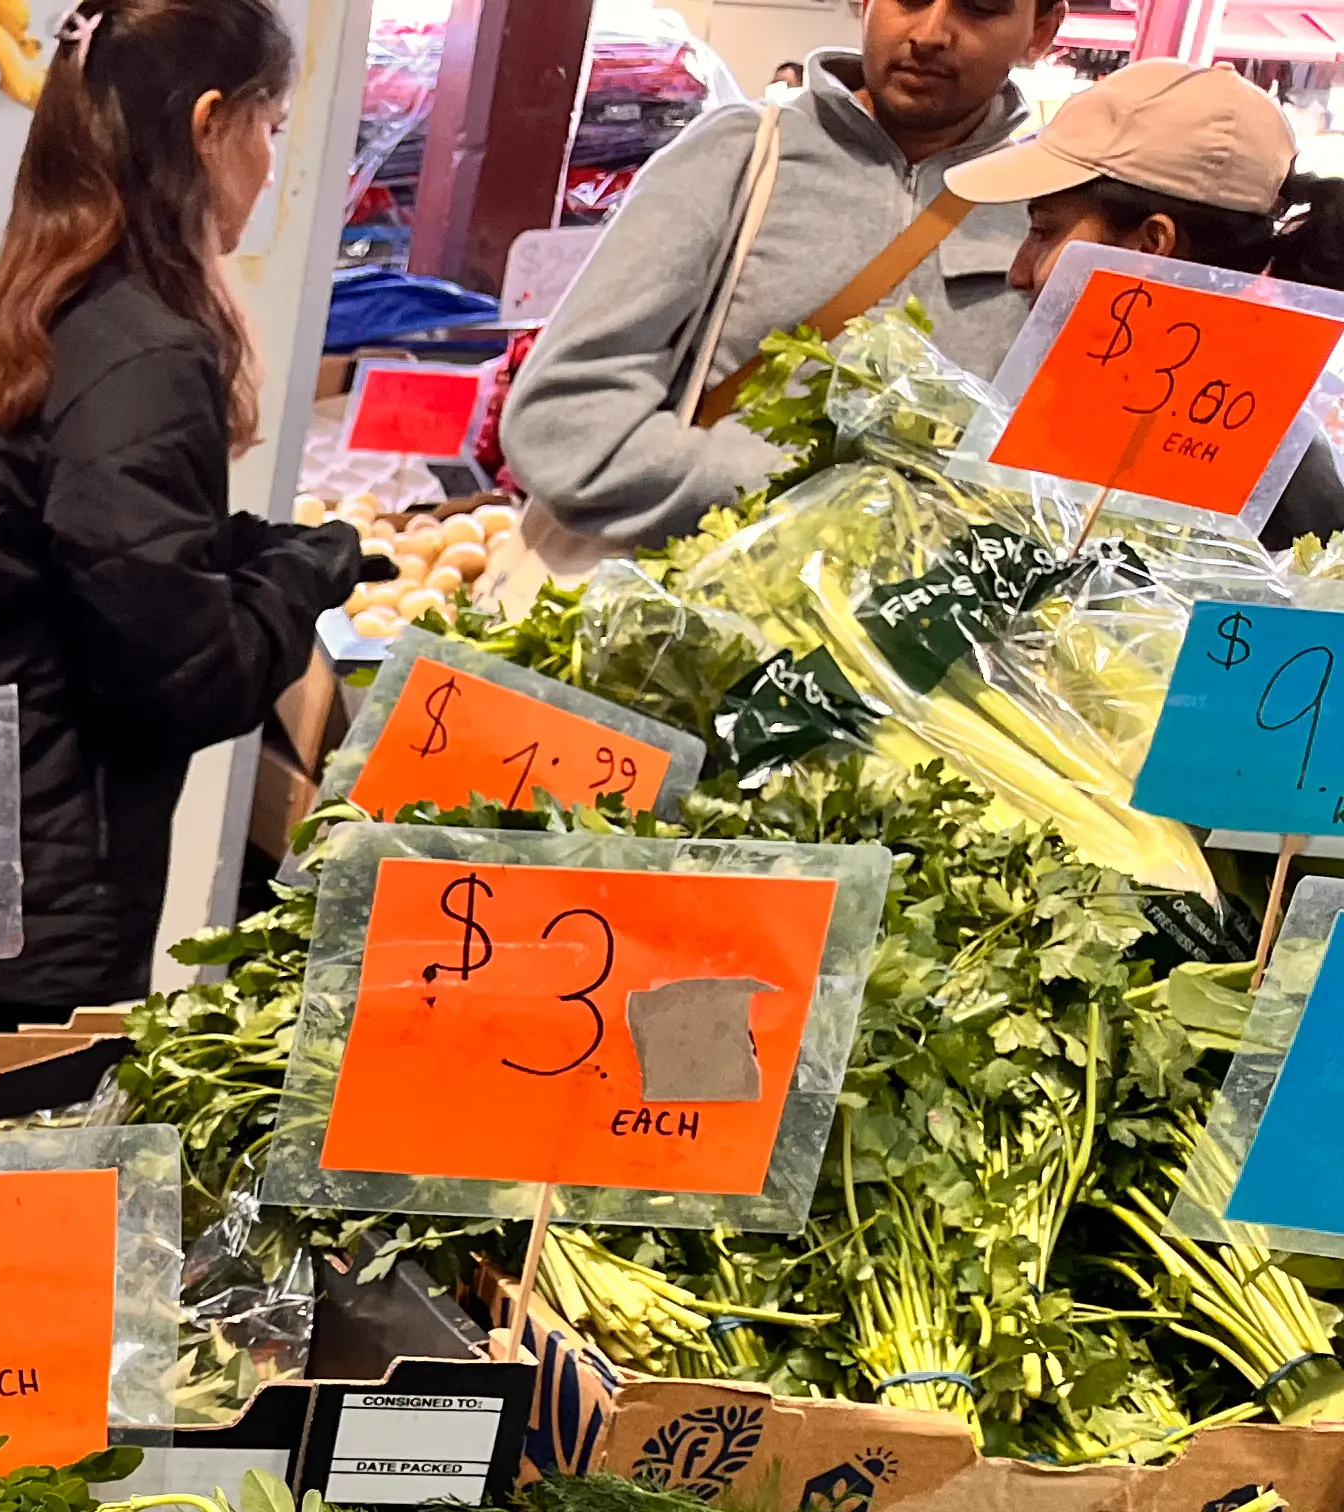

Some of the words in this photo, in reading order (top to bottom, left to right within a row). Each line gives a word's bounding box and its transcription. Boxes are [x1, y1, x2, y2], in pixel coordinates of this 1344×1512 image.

[1162, 432, 1220, 463] EACH
[611, 1107, 700, 1140] EACH
[362, 1395, 453, 1408] CONSIGNED
[457, 1398, 482, 1408] TO:
[356, 1462, 396, 1473] DATE
[400, 1463, 463, 1474] PACKED
